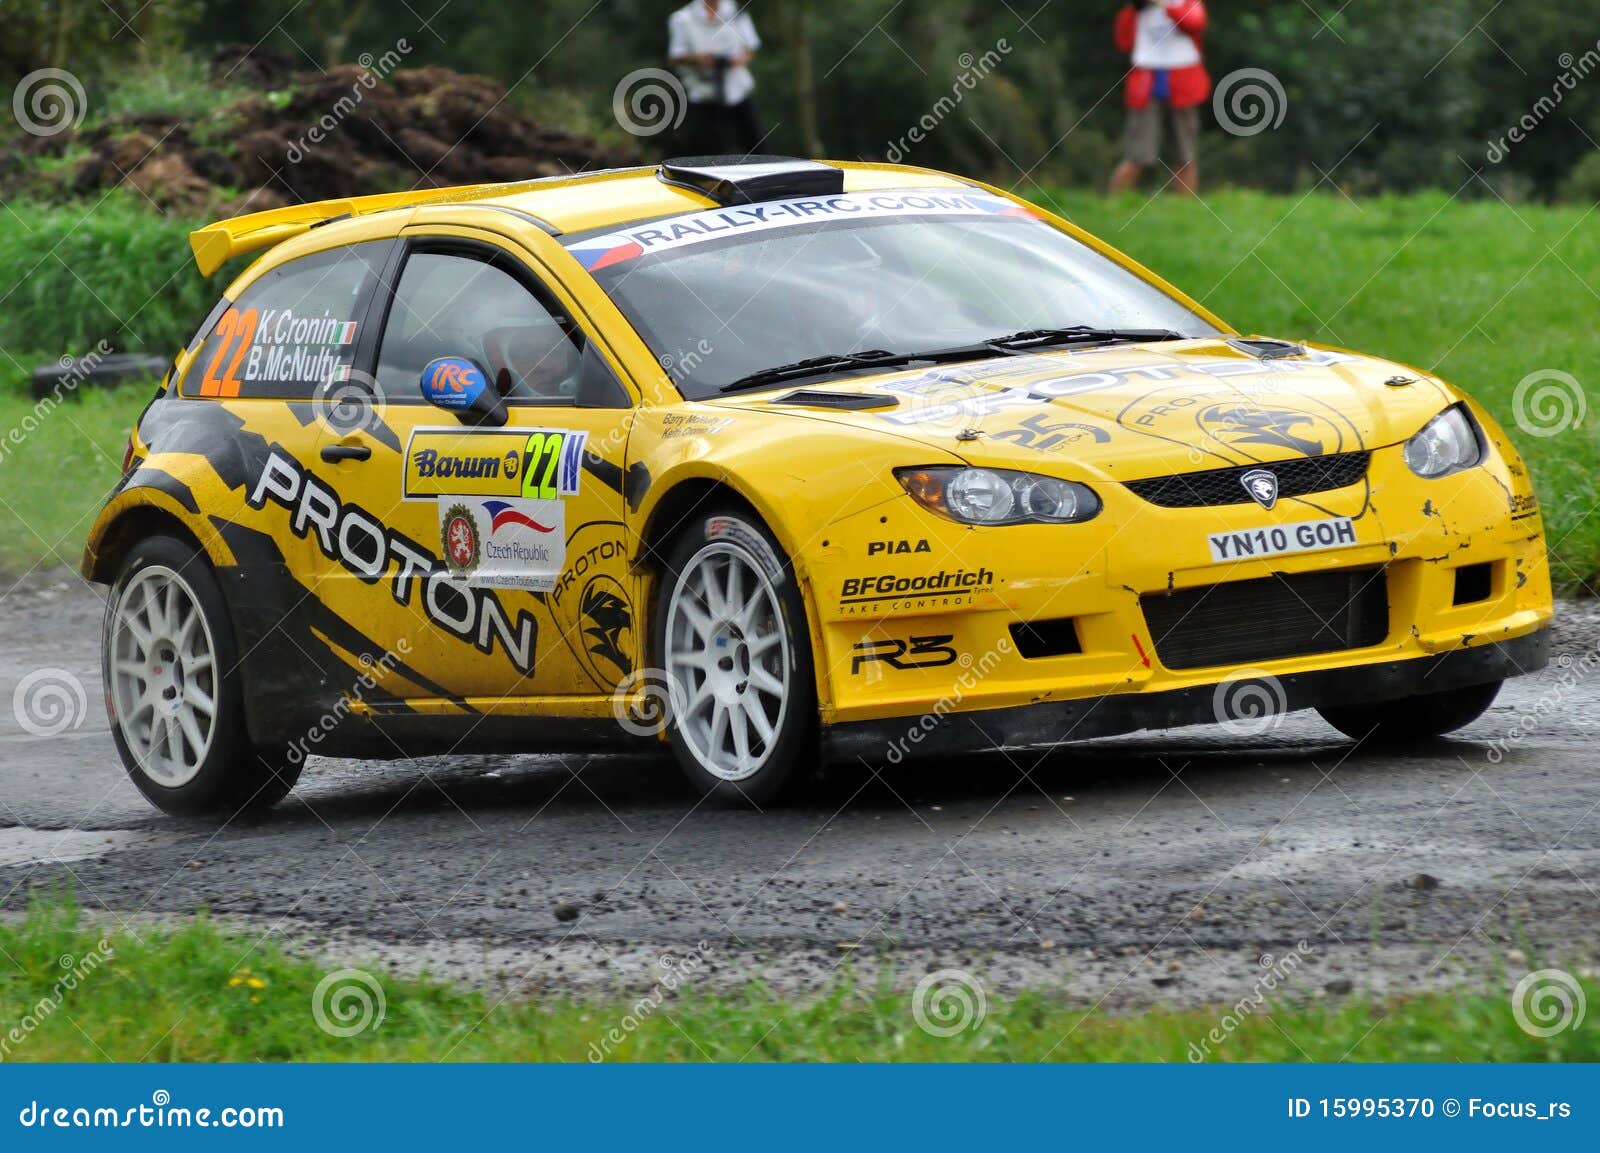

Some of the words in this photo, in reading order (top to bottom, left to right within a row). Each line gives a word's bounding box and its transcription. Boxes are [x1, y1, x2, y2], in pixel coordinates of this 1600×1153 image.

[632, 193, 976, 248] RALLY-IRC.COM
[254, 308, 337, 345] K.Cronin
[200, 308, 258, 397] 22
[245, 345, 341, 391] B.McNulty
[414, 449, 500, 478] Barum
[522, 432, 563, 499] 22
[562, 434, 585, 491] N
[486, 541, 513, 560] Czech
[514, 542, 550, 563] Republic
[867, 539, 932, 556] PIAA
[1210, 528, 1288, 559] YN10
[1295, 520, 1356, 548] GOH
[250, 450, 534, 672] PROTON
[841, 567, 994, 597] BFGoodrich
[838, 603, 880, 615] TAKE
[893, 597, 974, 611] CONTROL
